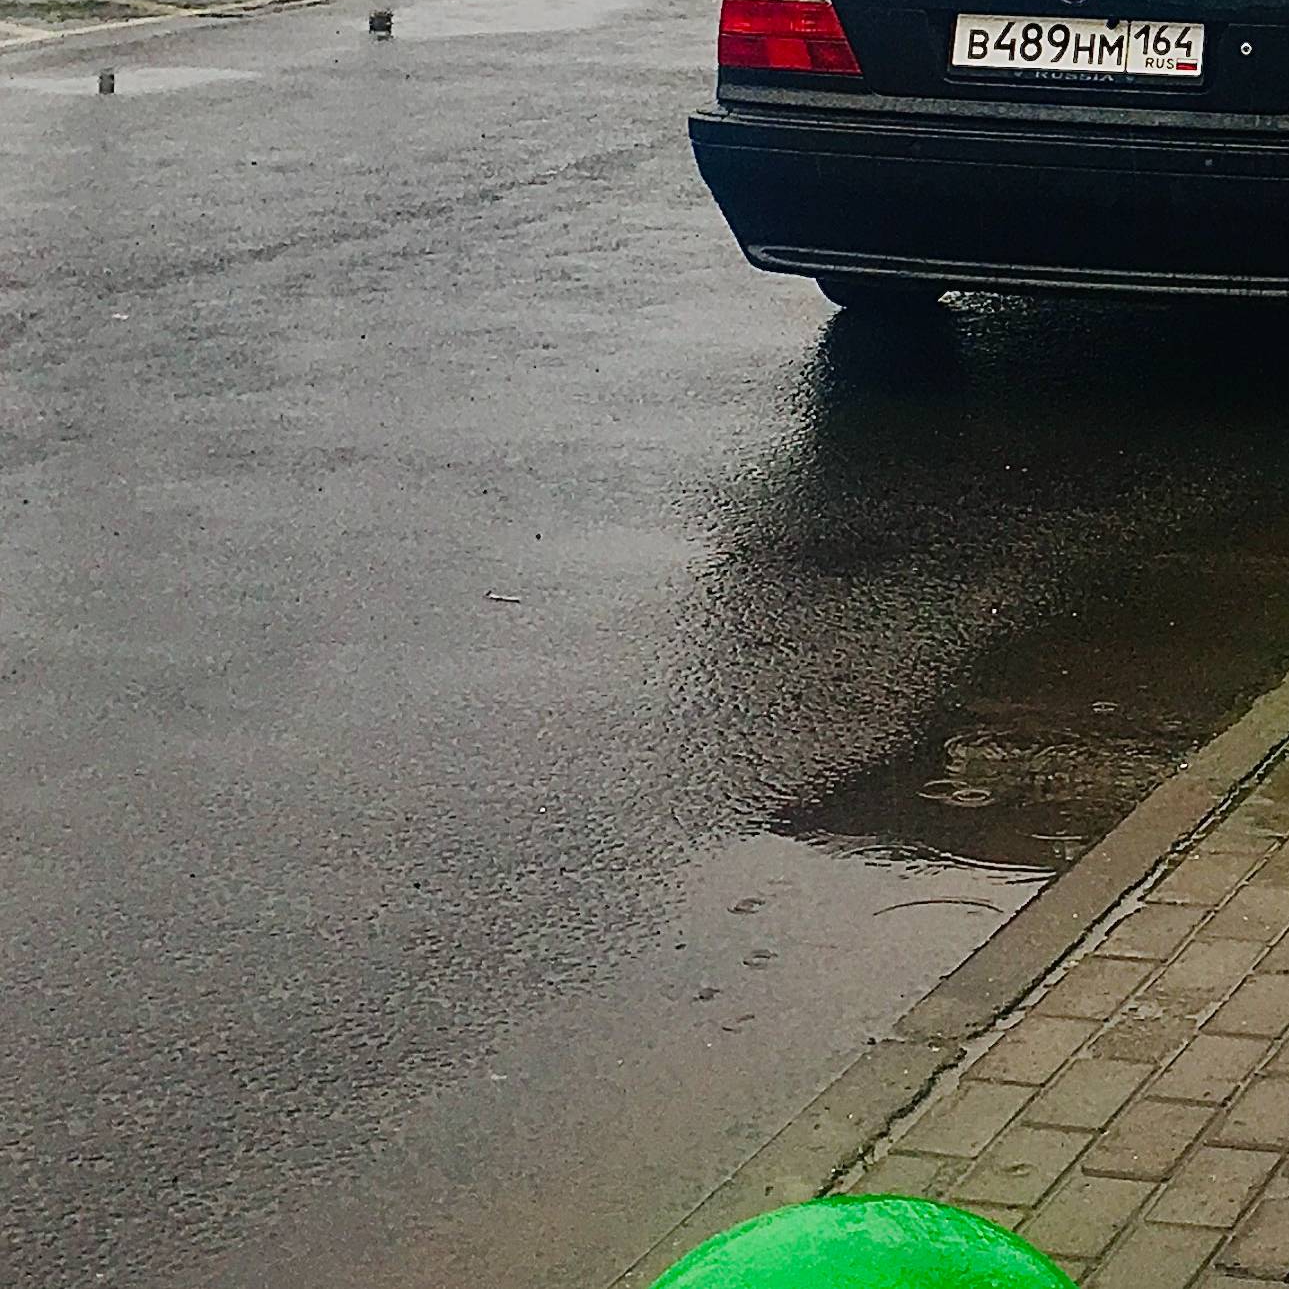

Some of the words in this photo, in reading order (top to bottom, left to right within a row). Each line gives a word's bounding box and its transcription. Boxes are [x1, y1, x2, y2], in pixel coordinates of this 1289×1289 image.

[967, 21, 1125, 66] В489НМ
[1133, 24, 1193, 58] 164
[1144, 57, 1175, 70] RUS
